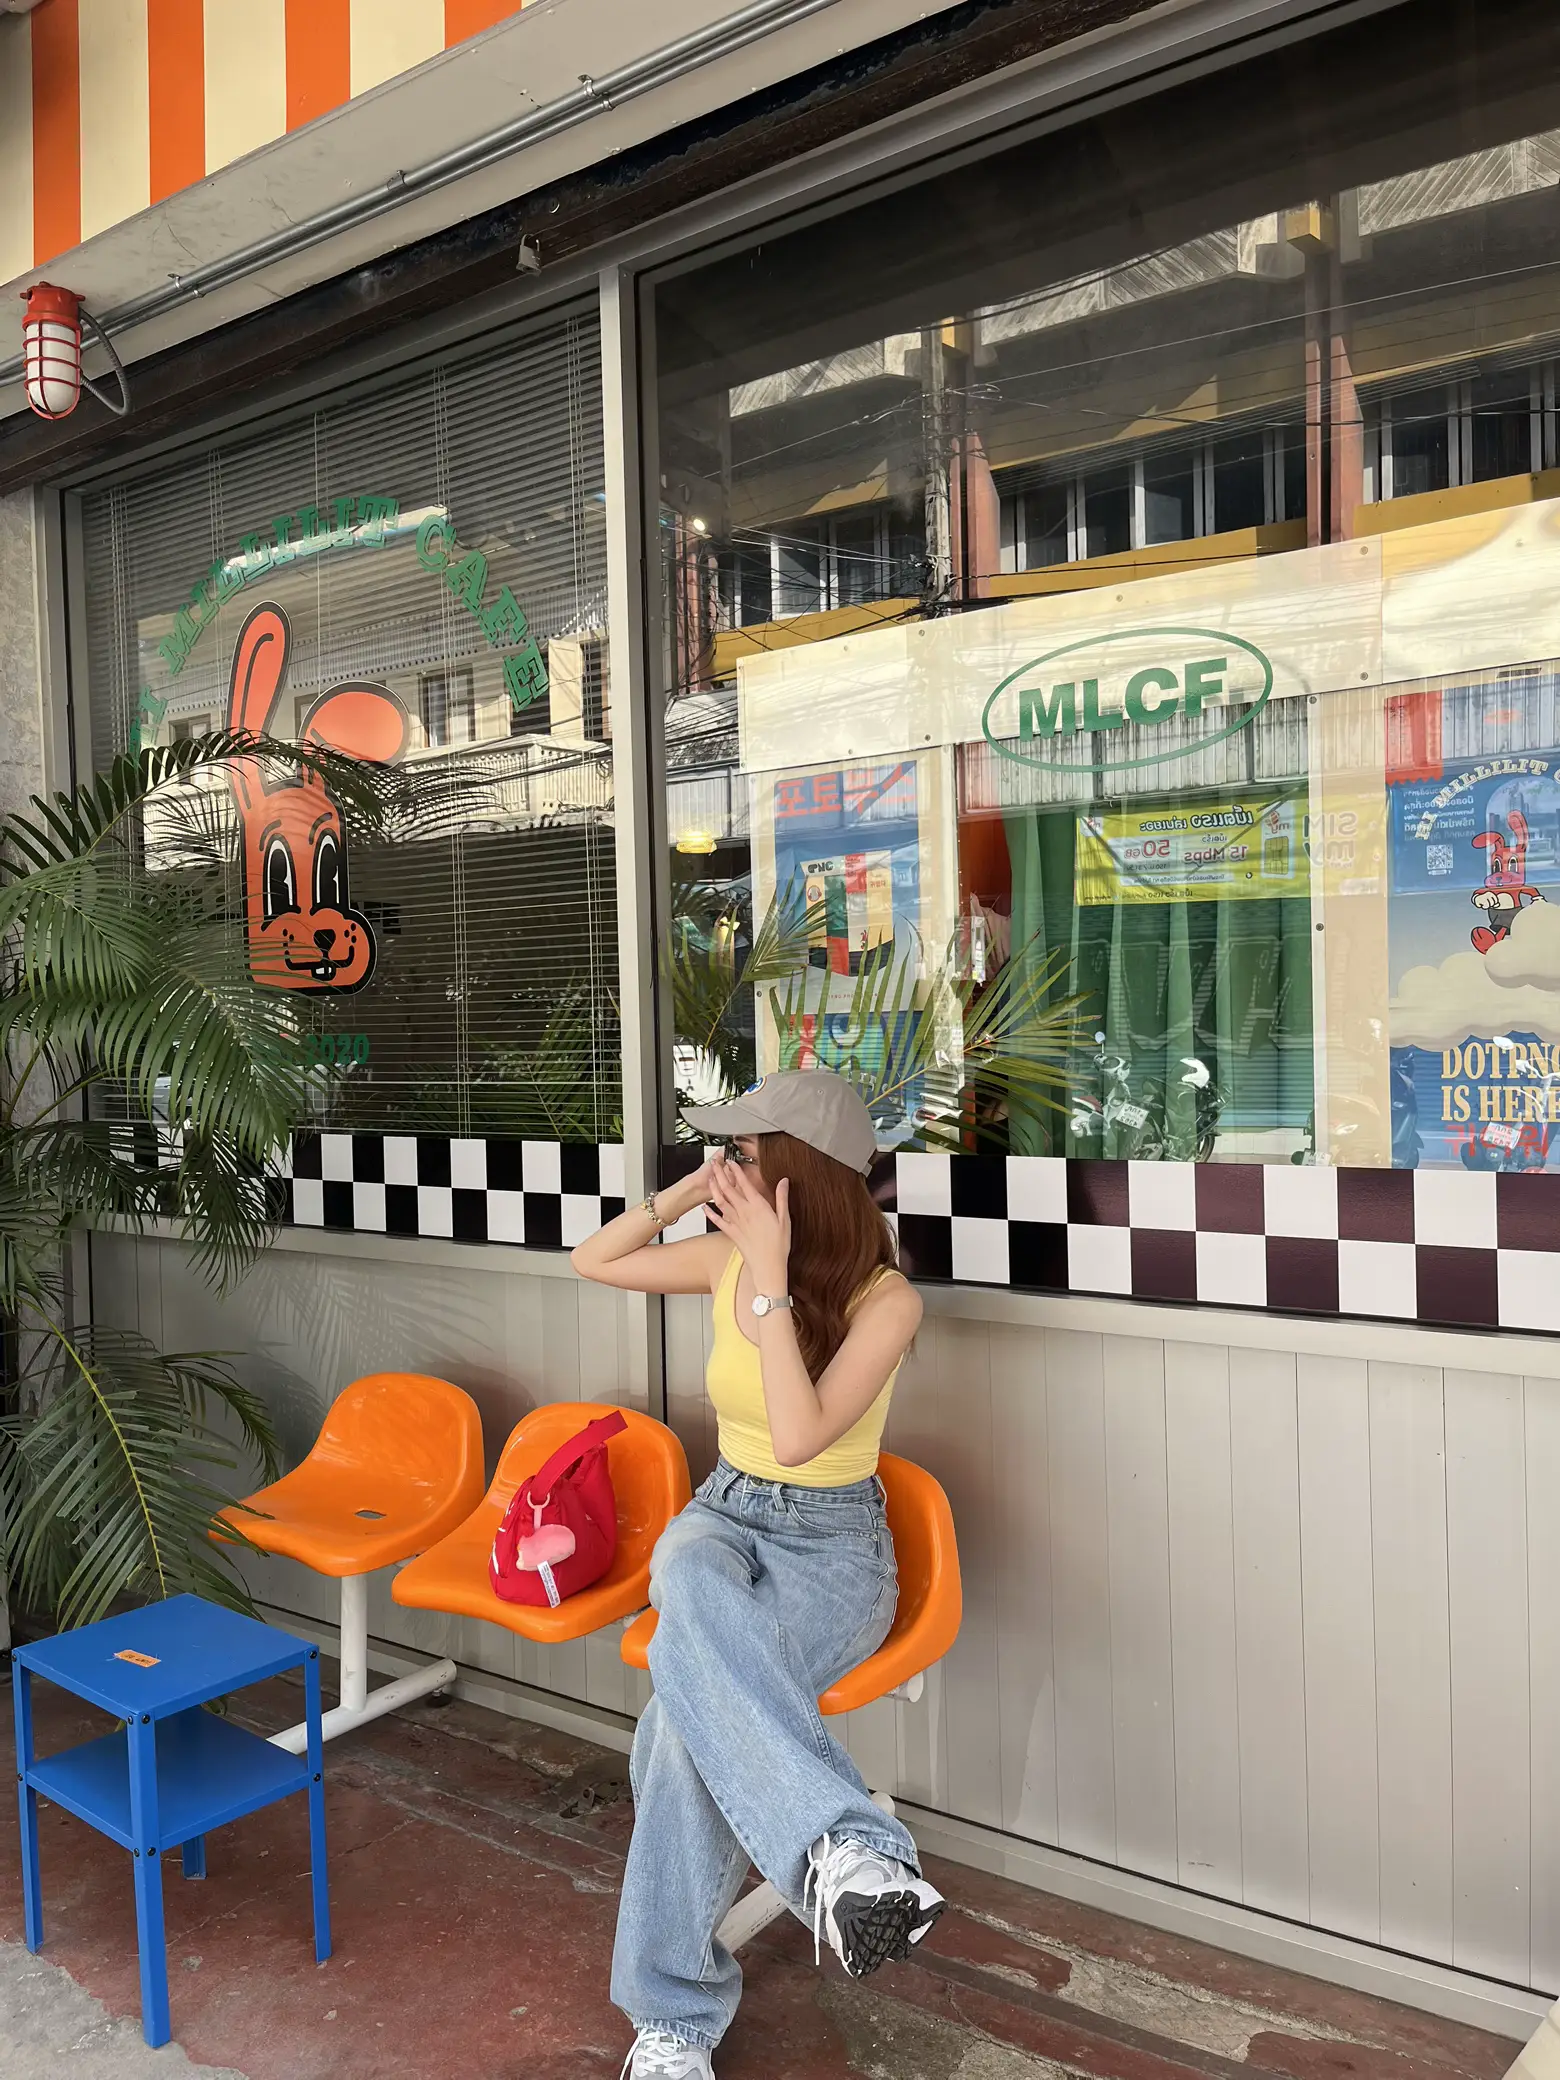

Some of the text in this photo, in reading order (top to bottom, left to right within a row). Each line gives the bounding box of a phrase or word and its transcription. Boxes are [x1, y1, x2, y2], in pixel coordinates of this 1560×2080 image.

[157, 496, 399, 675] MILLILIT
[415, 513, 550, 713] CAFE
[1019, 657, 1227, 742] MLCF
[775, 762, 916, 818] 포토부스
[1431, 758, 1549, 809] MILLILIT
[1441, 1085, 1471, 1122] IS
